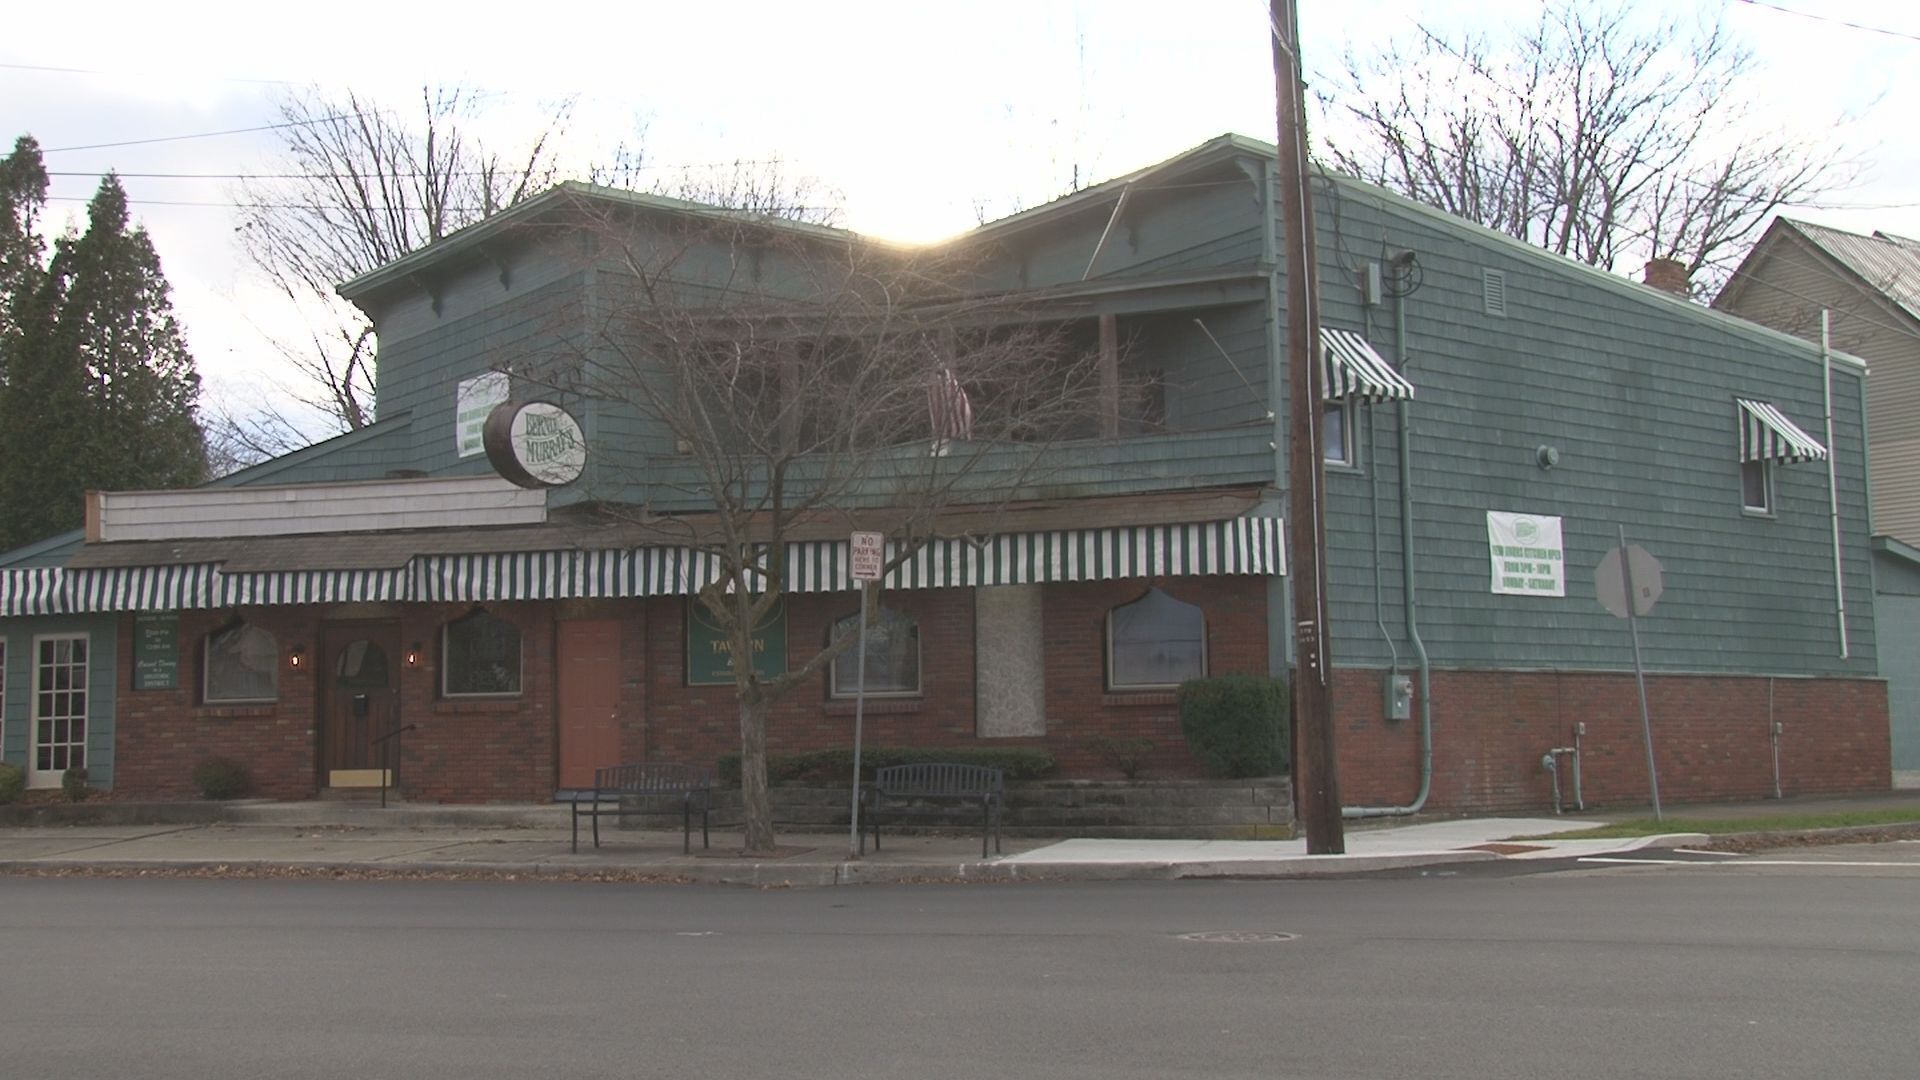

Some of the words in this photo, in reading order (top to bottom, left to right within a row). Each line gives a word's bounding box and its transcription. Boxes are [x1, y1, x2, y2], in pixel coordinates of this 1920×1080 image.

[862, 536, 873, 546] NO
[853, 546, 881, 557] PARKING
[711, 639, 764, 653] TAVN
